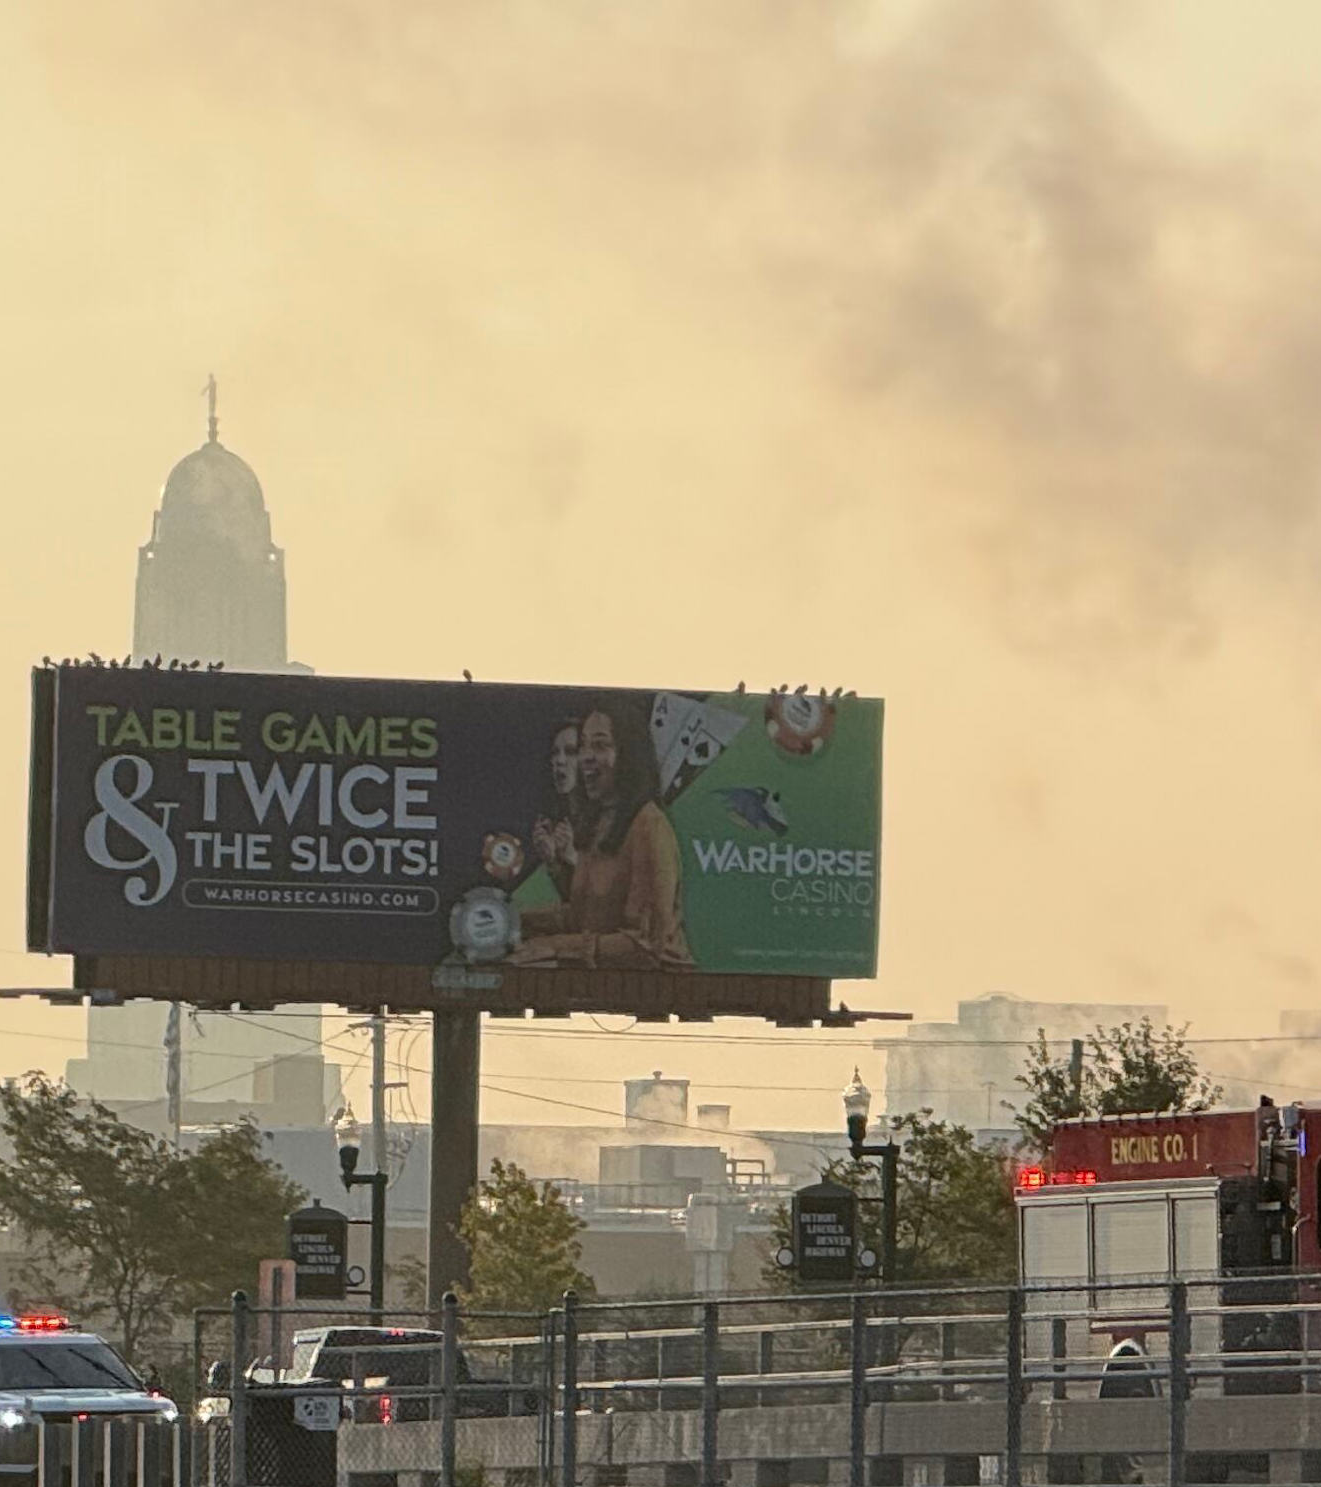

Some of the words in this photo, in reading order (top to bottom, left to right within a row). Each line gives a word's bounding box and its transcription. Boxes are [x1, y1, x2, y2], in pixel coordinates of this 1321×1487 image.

[86, 705, 241, 751] TABLE
[261, 711, 439, 758] GAMES
[188, 758, 438, 829] TWICE
[84, 754, 180, 906] &
[185, 832, 272, 870] THE
[290, 836, 439, 876] SLOTS!
[204, 886, 419, 906] WARHORSECASINO.COM
[771, 878, 873, 905] CASINO
[1111, 1135, 1159, 1165] ENGINE
[1163, 1133, 1188, 1163] CO.
[1191, 1133, 1198, 1161] 1
